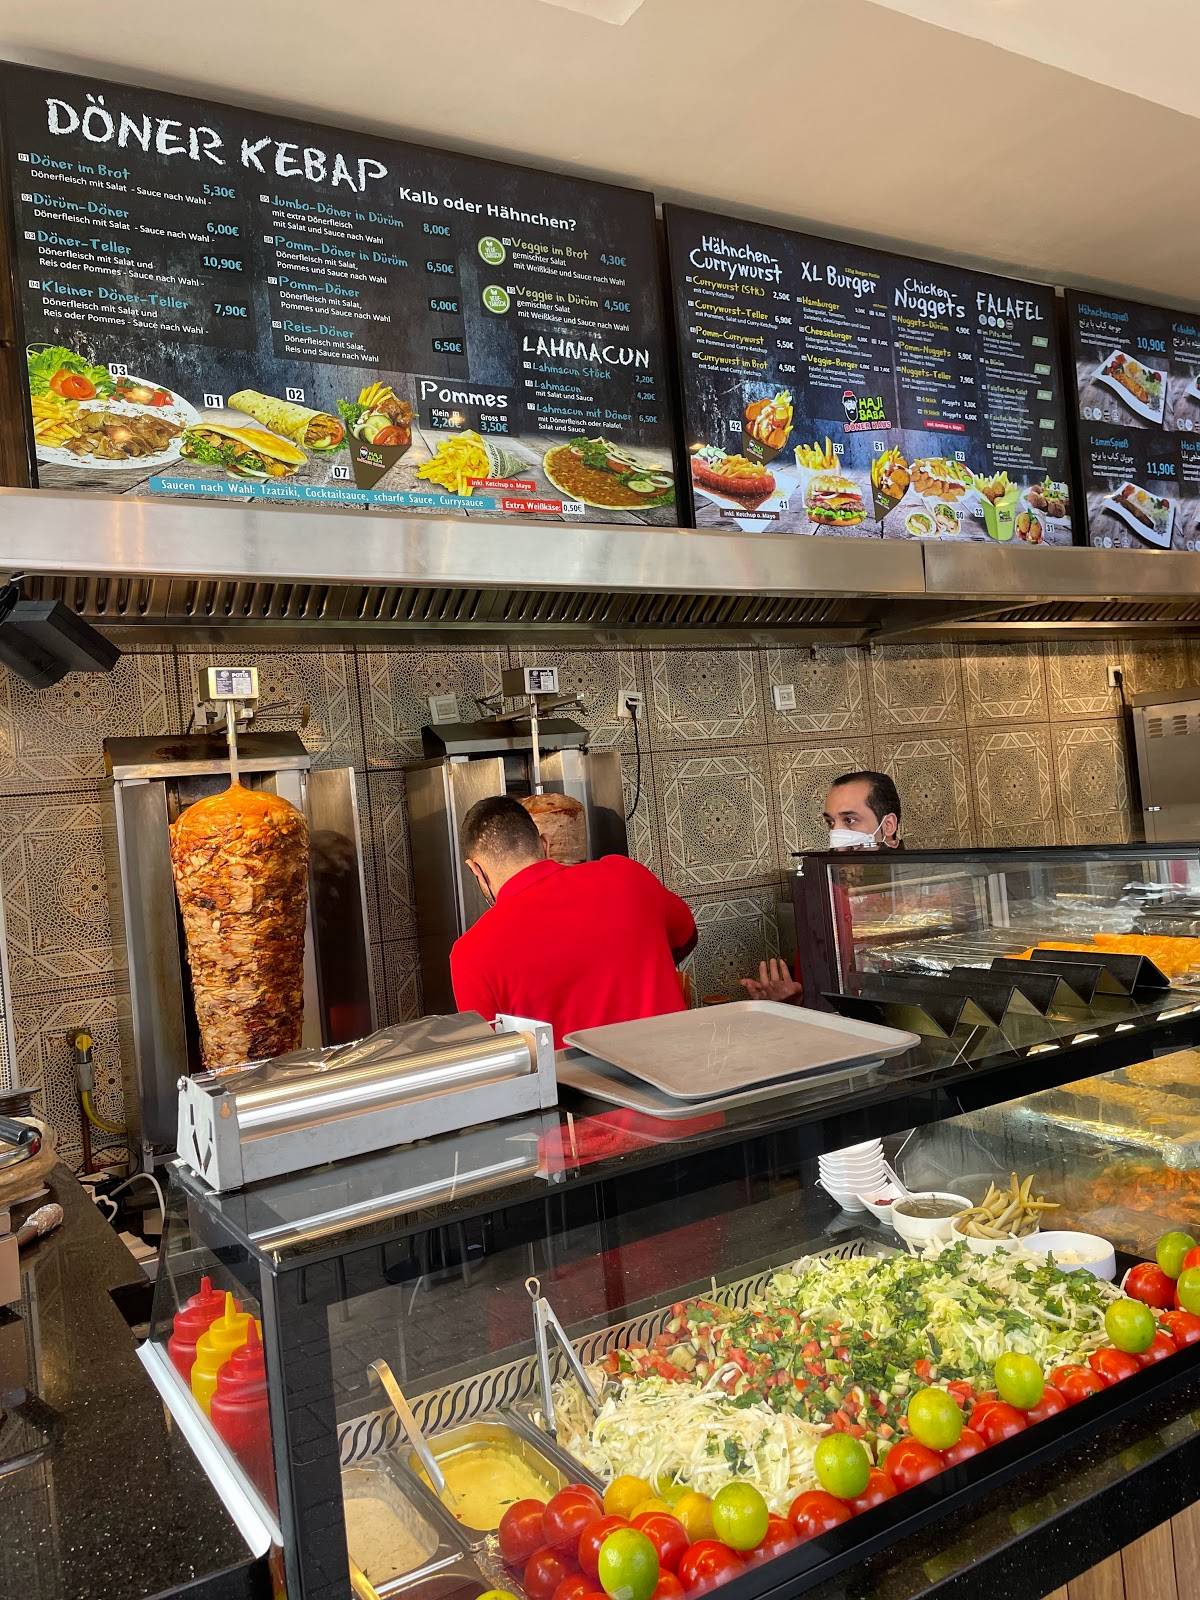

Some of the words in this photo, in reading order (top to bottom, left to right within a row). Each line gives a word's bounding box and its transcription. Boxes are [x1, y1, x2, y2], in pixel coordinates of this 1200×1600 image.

[45, 94, 226, 165] DÖNER
[241, 136, 388, 192] KEBAP
[30, 153, 74, 171] Döner
[78, 162, 93, 174] im
[99, 165, 131, 180] Brot
[31, 170, 86, 185] Dönerfleisch
[89, 180, 103, 188] mit
[106, 181, 126, 192] Salat
[136, 186, 161, 198] Sauce
[164, 193, 183, 201] nach
[185, 195, 206, 205] Wahl
[203, 184, 236, 199] 5,30€
[22, 194, 32, 202] 02
[33, 192, 129, 219] Dürüm-Döner
[271, 195, 352, 218] Jumbo-Döner
[356, 210, 365, 220] in
[369, 211, 403, 228] Dürüm
[400, 187, 438, 205] Kalb
[443, 198, 482, 215] oder
[487, 203, 577, 231] Hähnchen?
[272, 210, 285, 218] mit
[287, 212, 305, 222] extra
[308, 215, 353, 230] Dönerfleisch
[207, 222, 239, 236] 6,00€
[423, 224, 450, 236] 8,00€
[25, 232, 35, 240] 03
[38, 231, 132, 254] Döner-Teller
[512, 237, 548, 254] Veggie
[552, 245, 562, 255] im
[566, 247, 588, 260] Brot
[702, 236, 779, 264] Hähnchen-
[39, 247, 94, 262] Dönerfleisch
[114, 256, 134, 267] Salat
[137, 260, 154, 269] und
[275, 236, 355, 258] Pomm-Döner
[360, 251, 369, 260] in
[373, 252, 408, 267] Dürüm
[203, 256, 242, 271] 10,90€
[427, 262, 454, 274] 6,50€
[600, 254, 626, 267] 4,30€
[690, 249, 782, 284] Currywurst
[40, 258, 58, 267] Reis
[60, 260, 81, 271] oder
[84, 263, 121, 276] Pommes
[129, 270, 153, 280] Sauce
[156, 274, 175, 283] nach
[177, 277, 199, 287] Wahl
[801, 261, 822, 282] XL
[826, 266, 876, 298] Burger
[279, 276, 360, 297] Pomm-Döner
[693, 276, 739, 291] Currywurst
[904, 278, 958, 298] Chicken-
[42, 280, 93, 297] Kleiner
[99, 288, 189, 309] Döner-Teller
[280, 291, 326, 304] Dönerfleisch
[342, 299, 362, 309] Salat,
[516, 285, 553, 302] Veggie
[556, 293, 565, 302] in
[568, 293, 599, 308] Dürüm
[773, 292, 790, 301] 2,50€
[214, 304, 247, 317] 7,90€
[431, 300, 458, 312] 6,00€
[604, 300, 630, 313] 4,50€
[695, 300, 768, 320] Currywurst-Teller
[802, 296, 839, 311] Hamburger
[894, 288, 965, 319] Nuggets
[976, 291, 1043, 320] FALAFEL
[775, 316, 792, 325] 6,90€
[284, 320, 354, 339] Reis-Döner
[696, 326, 764, 345] Pomm-Currywurst
[805, 326, 852, 341] Cheeseburger
[435, 340, 462, 353] 6,50€
[523, 335, 649, 368] LAHMACUN
[777, 340, 794, 349] 5,50€
[899, 341, 951, 357] Pomm-Nuggets
[1137, 337, 1166, 352] 10,90€
[699, 352, 740, 365] Currywurst
[752, 360, 768, 369] Brot
[779, 364, 796, 372] 4,50€
[806, 354, 858, 370] Veggie-Burger
[111, 364, 126, 376] 03
[533, 362, 580, 377] Lahmacun
[901, 366, 951, 380] Nuggets-Teller
[534, 380, 582, 393] Lahmacun
[636, 375, 654, 384] 2,20€
[206, 396, 222, 407] 01
[288, 389, 303, 401] 02
[420, 381, 508, 408] Pommes
[637, 392, 656, 401] 4,20€
[859, 396, 883, 410] HAJI
[432, 409, 449, 417] Klein
[481, 414, 499, 422] Gross
[537, 403, 583, 417] Lahmacun
[587, 409, 601, 418] mit
[605, 409, 632, 421] Döner
[639, 415, 657, 423] 6,50€
[859, 409, 885, 421] BABA
[481, 421, 509, 433] 3,50€
[731, 422, 740, 430] 42
[335, 468, 347, 477] 07
[1146, 462, 1176, 476] 11,90€
[485, 480, 508, 489] Ketchup
[162, 480, 195, 490] Saucen
[201, 483, 223, 492] nach
[228, 483, 255, 494] Wahl:
[262, 485, 300, 497] Tzatziki,
[306, 488, 369, 502] Cocktailsauce,
[374, 493, 404, 503] scharfe
[409, 494, 435, 505] Sauce,
[440, 496, 484, 508] Currysauce
[506, 501, 524, 510] Extra
[563, 504, 582, 513] 0,50€
[779, 501, 788, 509] 41
